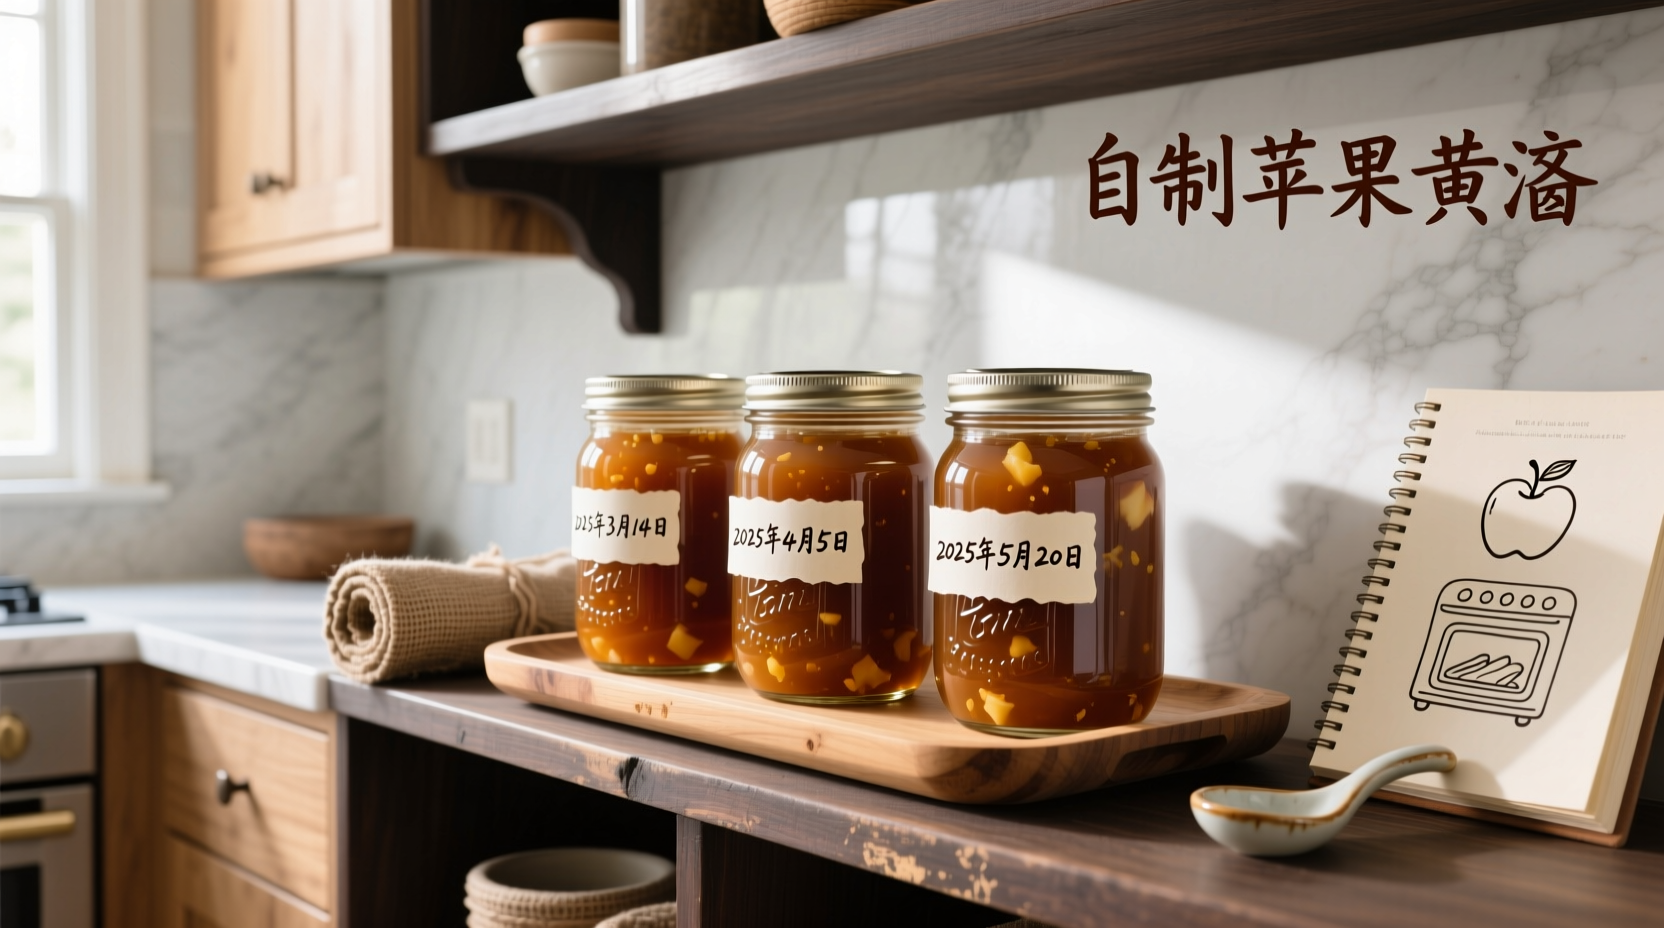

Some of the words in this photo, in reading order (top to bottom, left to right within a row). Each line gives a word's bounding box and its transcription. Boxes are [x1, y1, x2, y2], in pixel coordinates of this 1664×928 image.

[733, 523, 848, 555] 2025年4月5日
[936, 537, 1082, 571] 2025年5月20日
